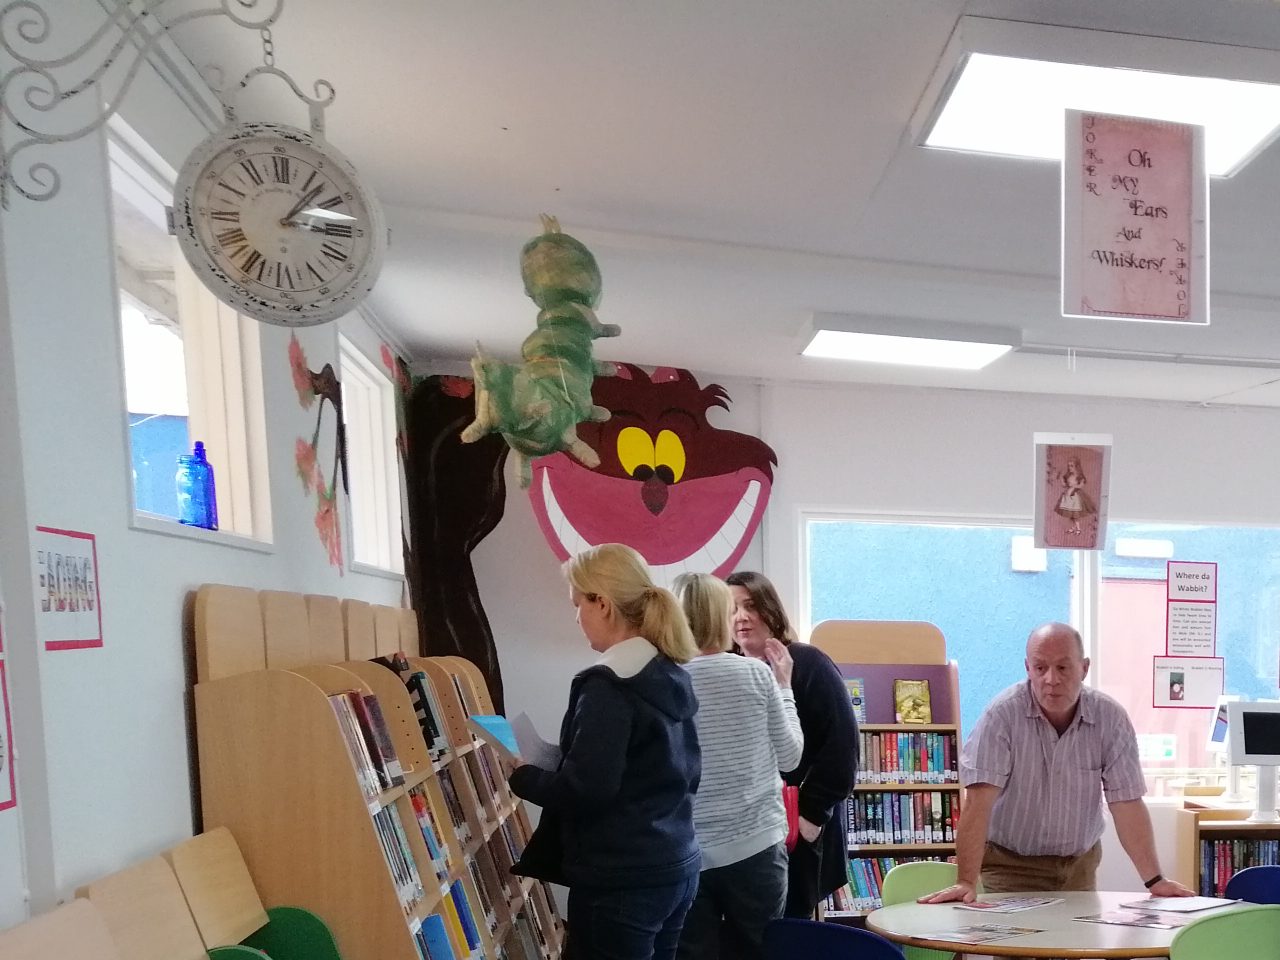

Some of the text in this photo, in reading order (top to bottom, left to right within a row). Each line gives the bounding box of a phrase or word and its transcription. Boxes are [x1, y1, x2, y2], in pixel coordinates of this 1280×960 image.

[1128, 149, 1152, 168] Oh
[1126, 199, 1169, 219] Ears
[1091, 250, 1166, 273] Whiskers!
[1175, 571, 1211, 580] Where da
[1177, 584, 1208, 592] Wabbit?
